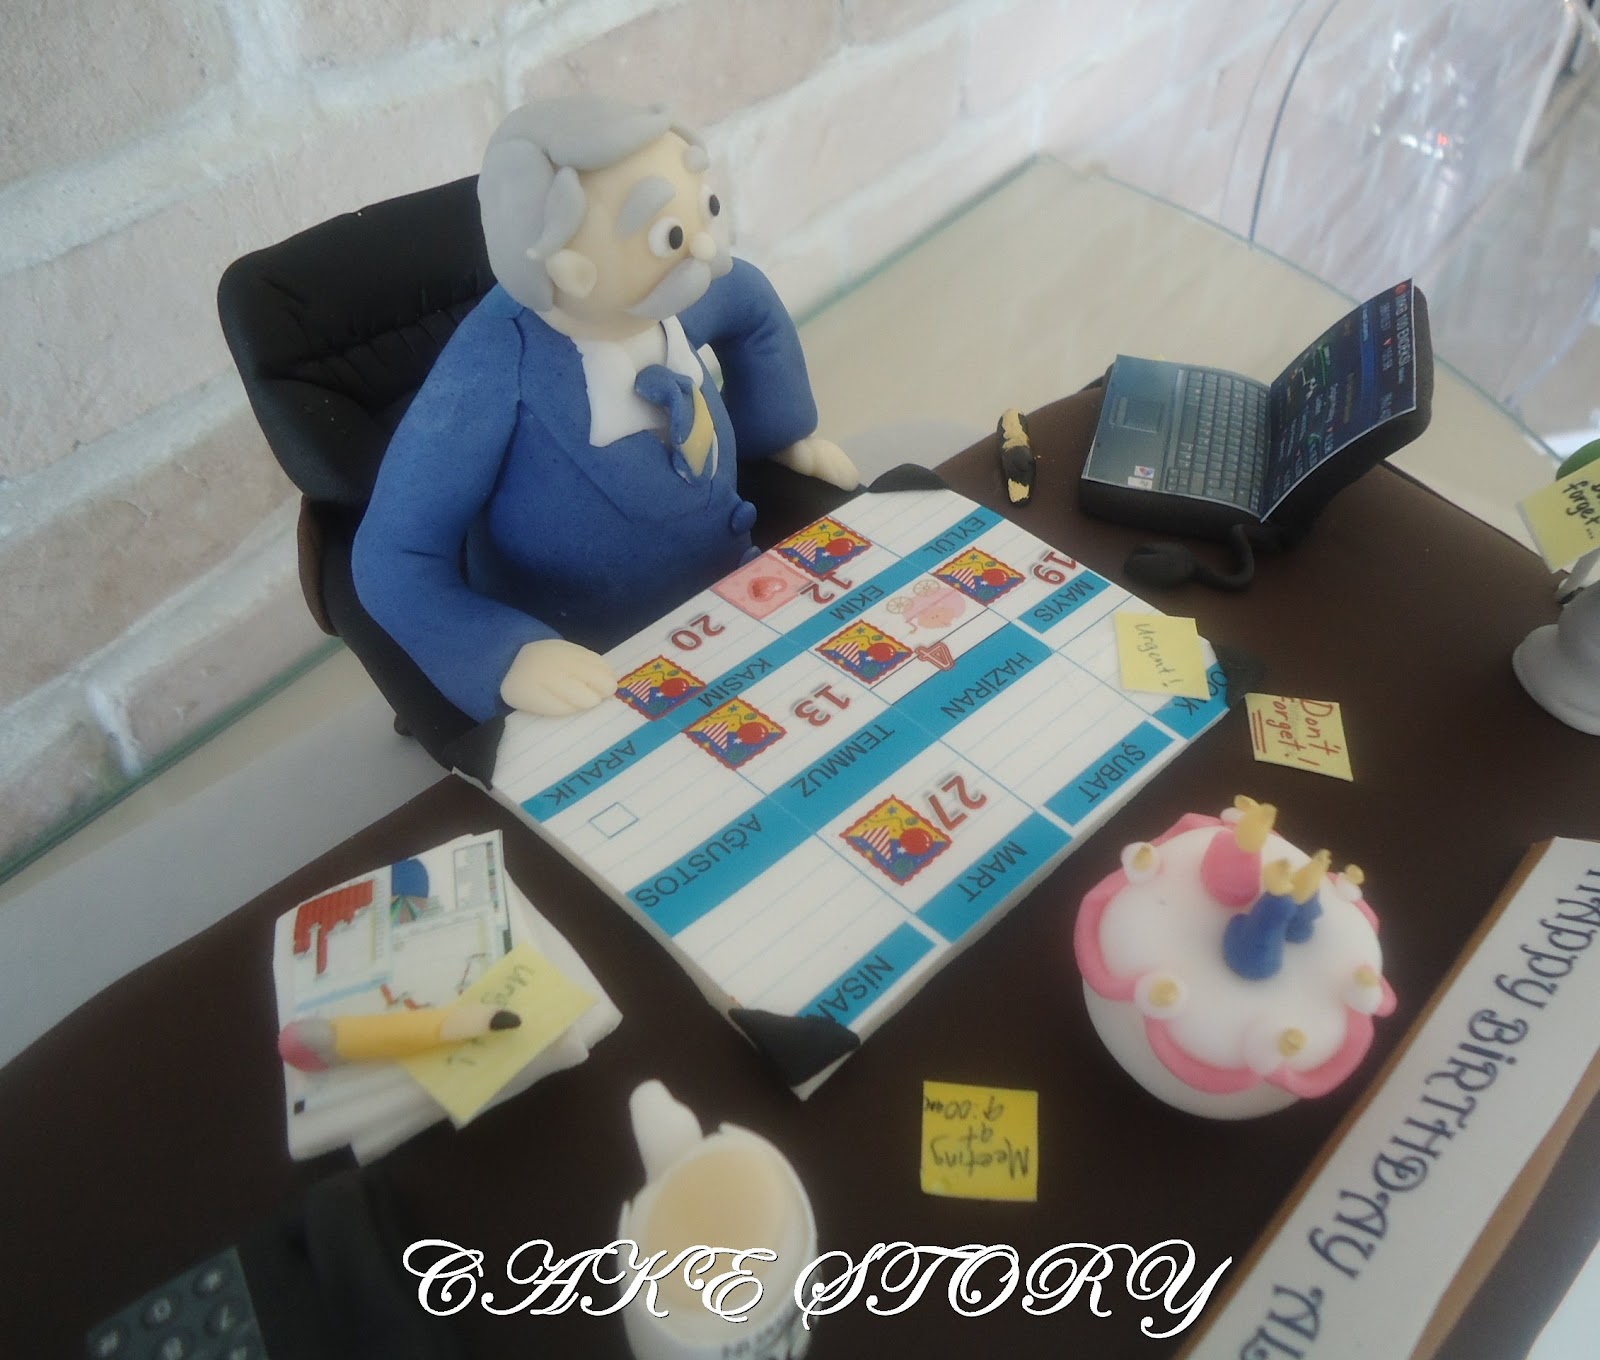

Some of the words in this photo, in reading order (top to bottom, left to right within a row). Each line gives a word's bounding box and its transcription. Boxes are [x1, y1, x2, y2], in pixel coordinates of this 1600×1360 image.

[923, 516, 986, 555] EYLÜL
[797, 571, 854, 604] 12
[1033, 550, 1077, 586] 19
[828, 585, 884, 621] EKİM
[1034, 580, 1095, 623] MAYIS
[671, 614, 725, 652] 20
[915, 641, 955, 672] 4
[697, 657, 773, 708] KASIM
[793, 683, 852, 727] 13
[940, 652, 1033, 719] HAZİRAN
[1174, 671, 1228, 716] OCK
[1300, 698, 1342, 756] Don't
[543, 740, 637, 806] ARALIK
[790, 723, 895, 798] TEMMUZ
[1078, 742, 1146, 804] ŞUBAT
[927, 774, 988, 832] 27
[634, 813, 763, 908] AĞUSTOS
[956, 840, 1028, 903] MART
[930, 1137, 1029, 1180] Meeting
